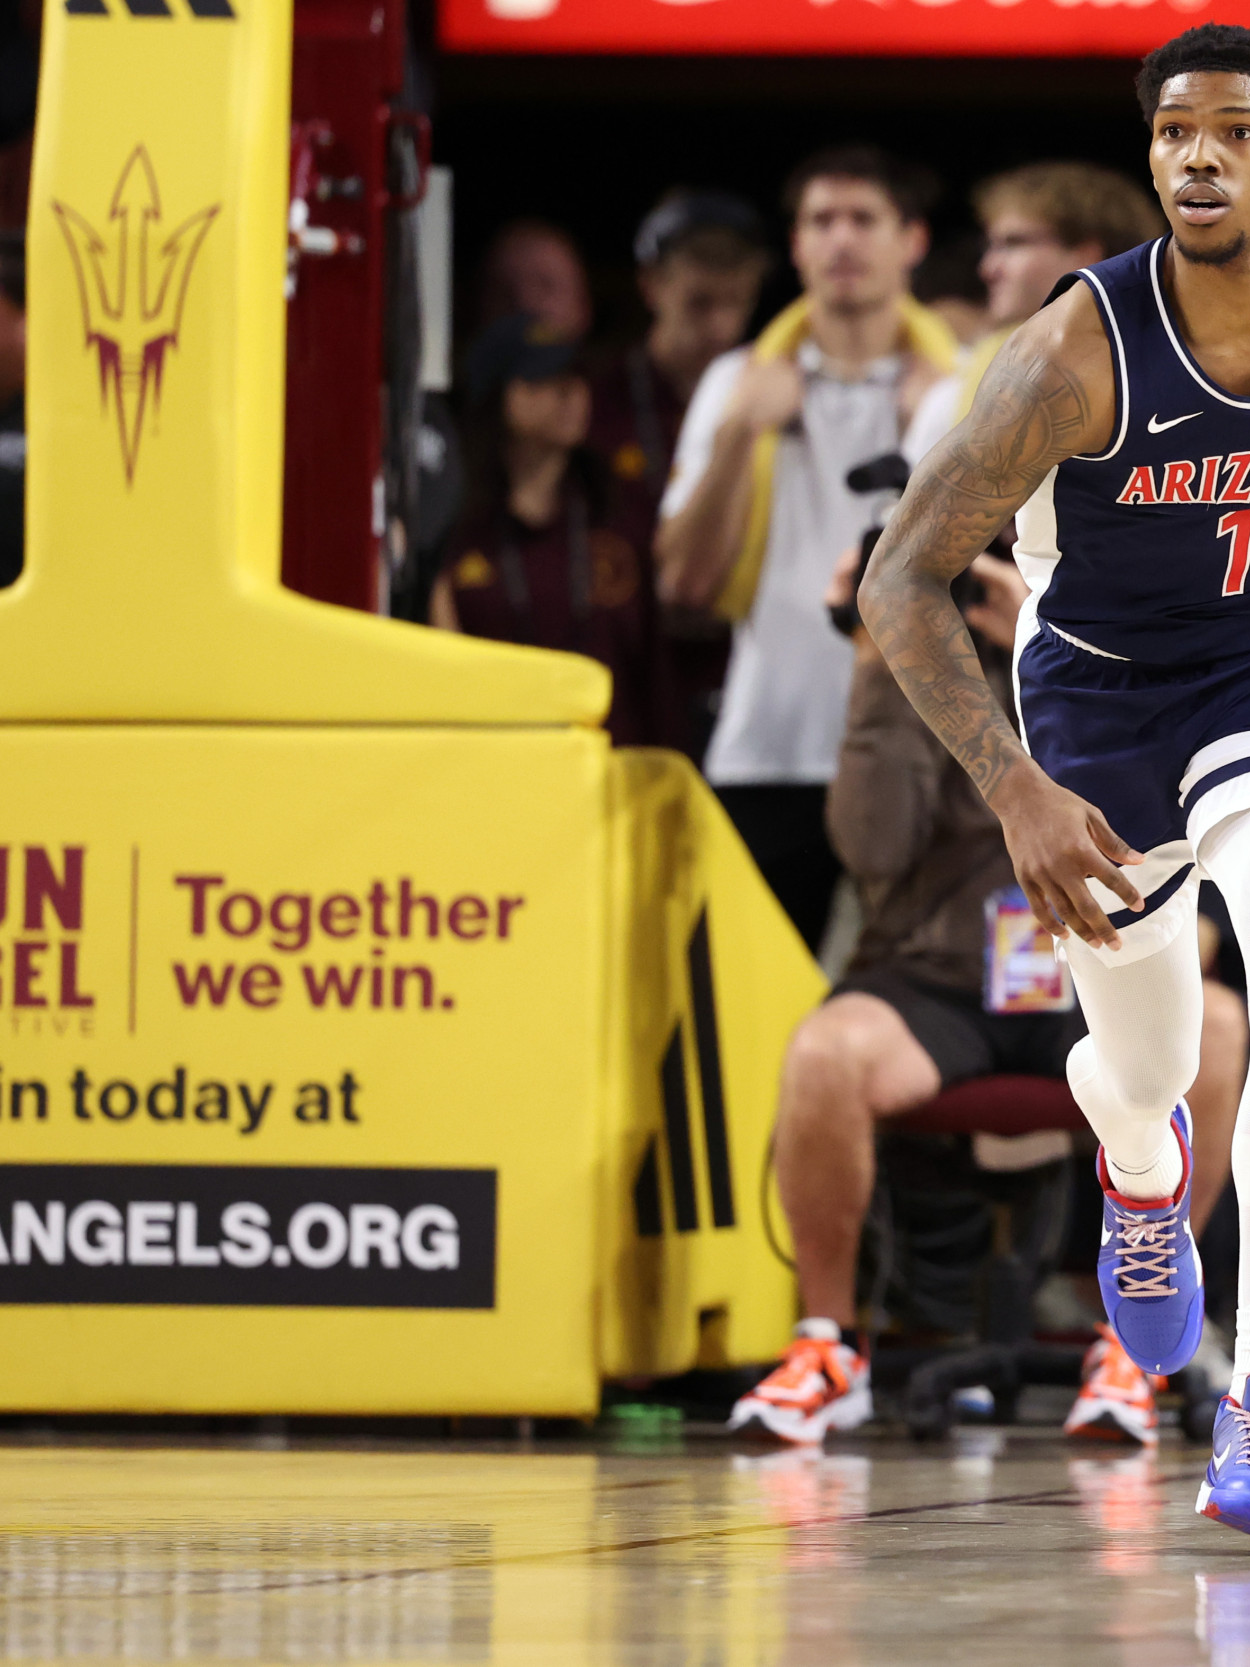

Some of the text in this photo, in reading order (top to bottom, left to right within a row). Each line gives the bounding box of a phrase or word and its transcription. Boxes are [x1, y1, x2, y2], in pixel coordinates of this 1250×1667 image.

[174, 875, 524, 953] Together
[0, 940, 95, 1008] EL
[172, 948, 455, 1010] we win.
[71, 1065, 274, 1135] today
[294, 1072, 360, 1124] at
